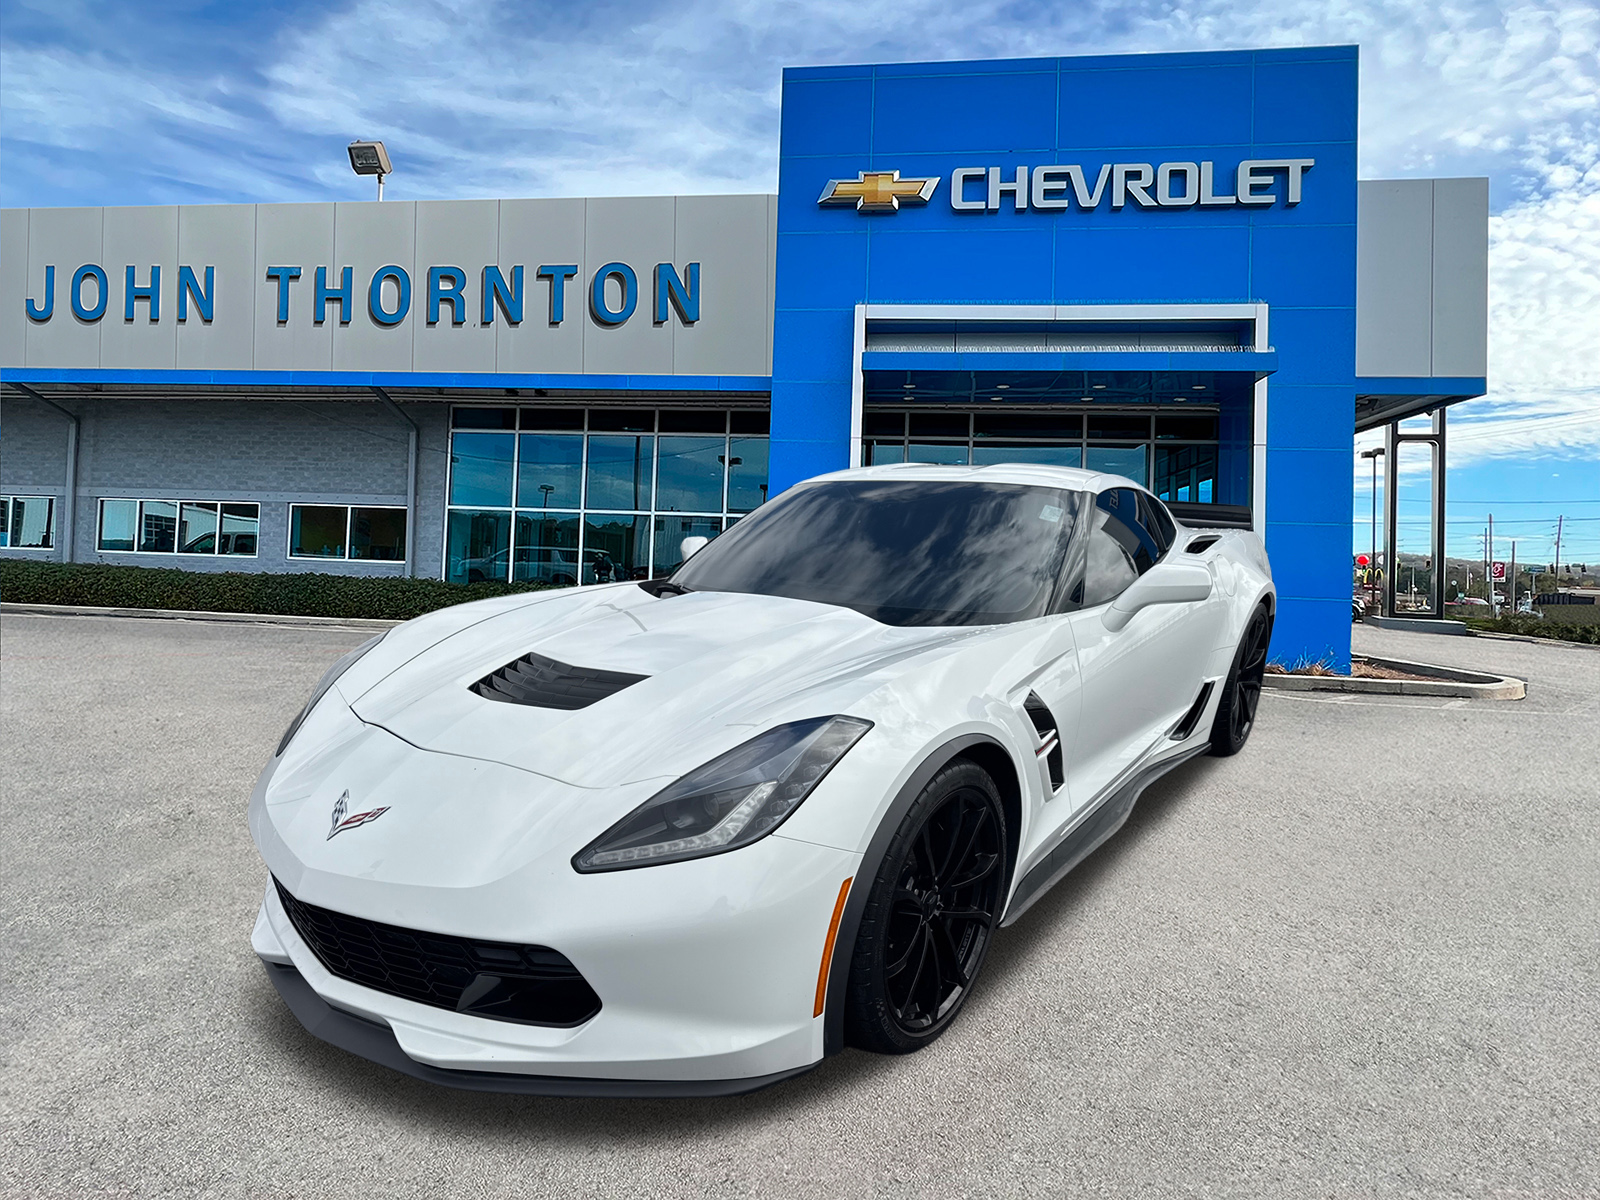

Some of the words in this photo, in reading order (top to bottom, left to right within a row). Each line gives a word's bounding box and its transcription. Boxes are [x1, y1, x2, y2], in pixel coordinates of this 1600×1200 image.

[951, 158, 1315, 211] CHEVROLET
[26, 264, 214, 321] JOHN
[267, 262, 701, 324] THORNTON
